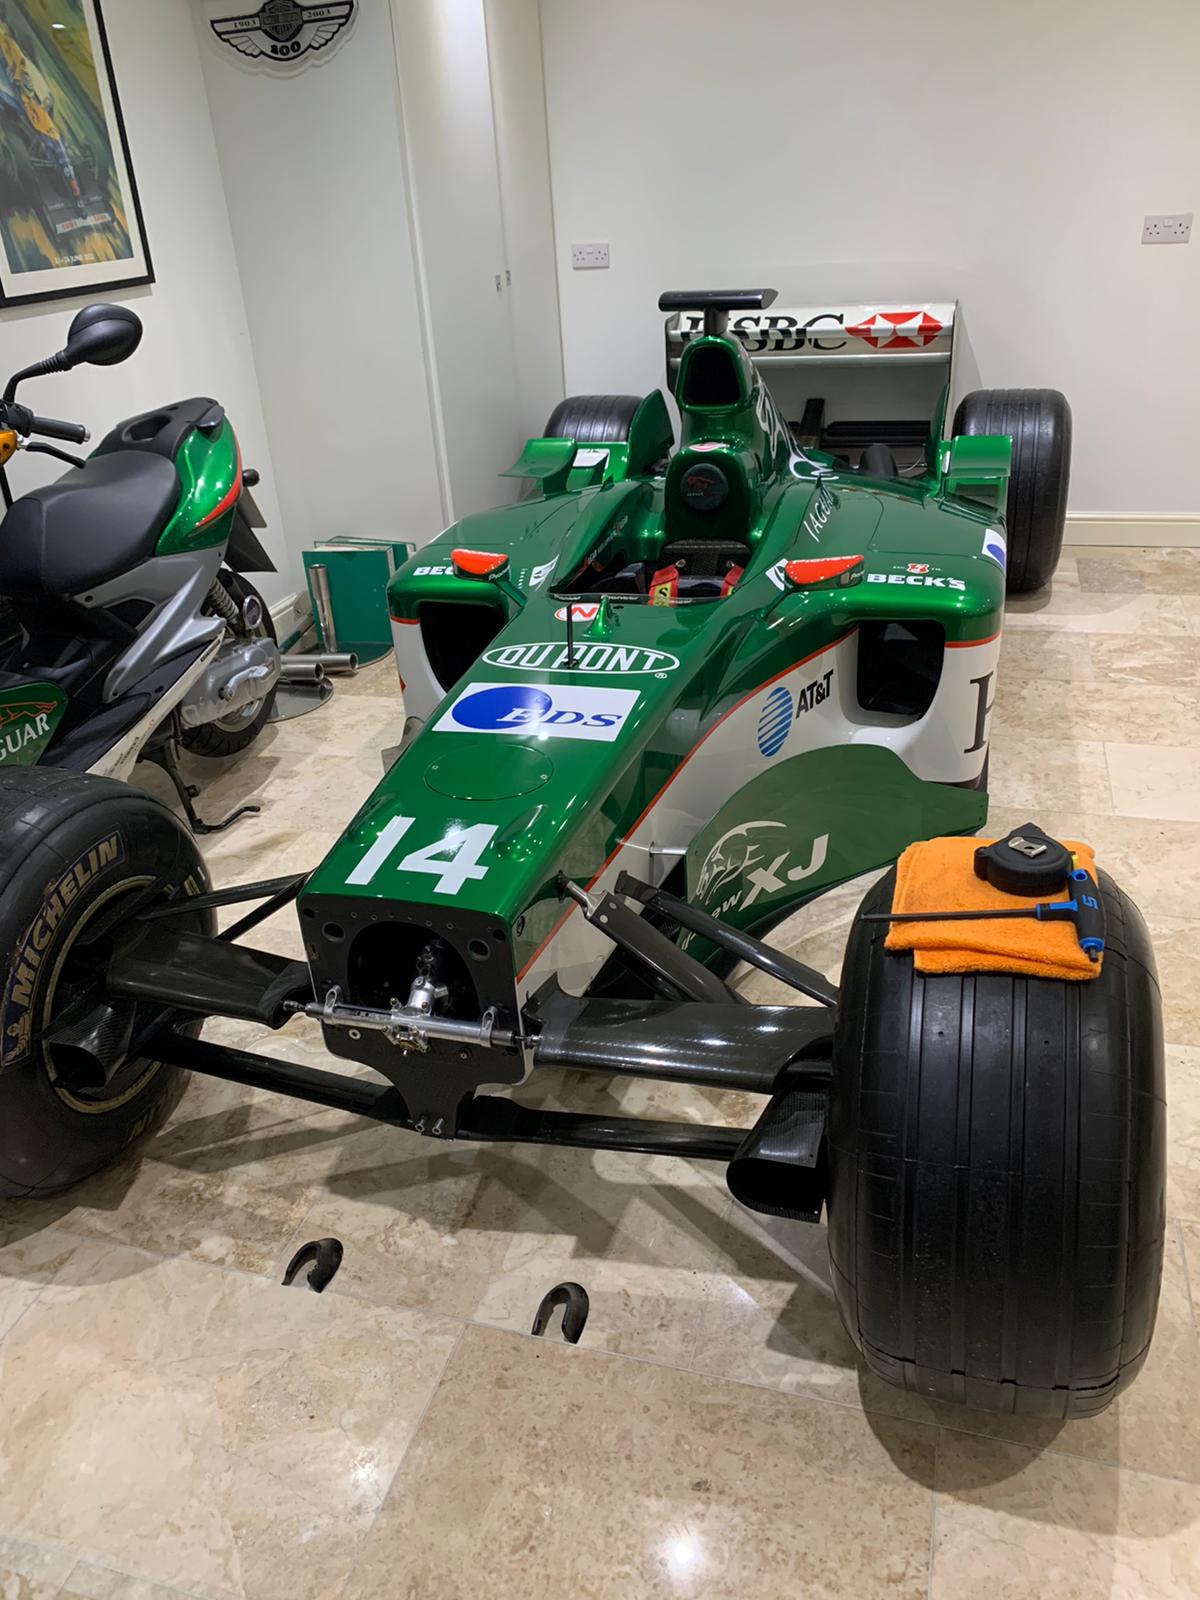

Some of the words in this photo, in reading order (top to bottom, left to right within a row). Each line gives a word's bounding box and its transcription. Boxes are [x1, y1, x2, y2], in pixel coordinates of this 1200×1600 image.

[866, 573, 966, 591] BECK'S
[496, 644, 552, 665] DU
[551, 645, 665, 672] PONT
[496, 707, 622, 727] EDS
[795, 668, 834, 719] AT&T
[344, 815, 499, 895] 14
[738, 833, 830, 912] XJ
[11, 835, 120, 1008] MICHELIN
